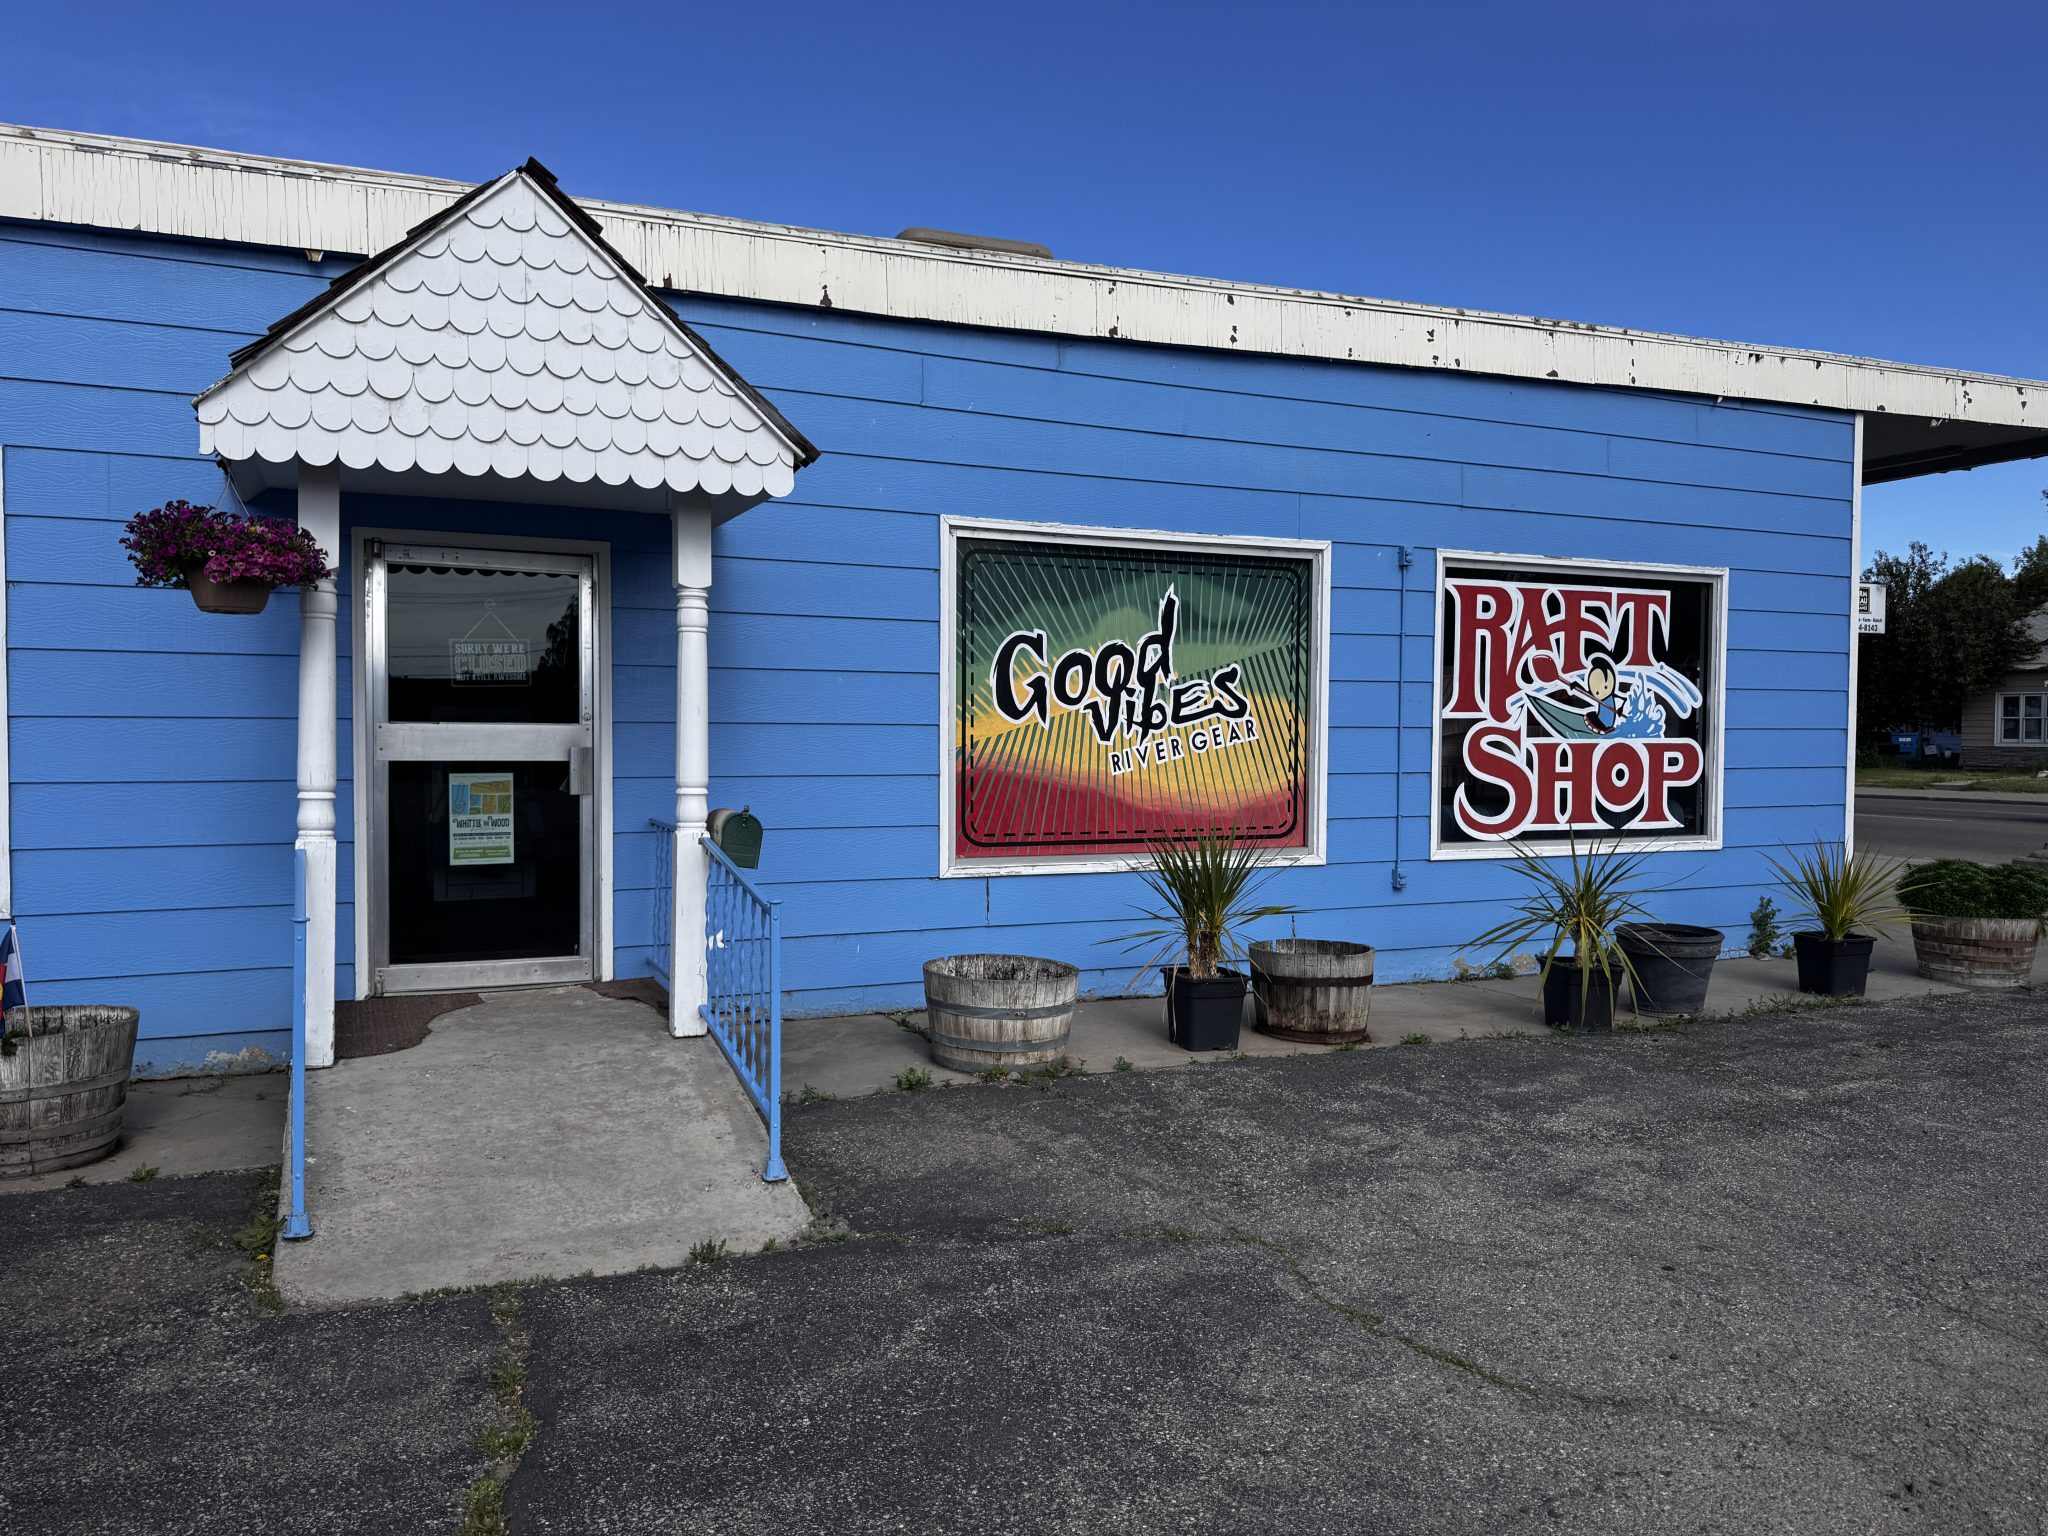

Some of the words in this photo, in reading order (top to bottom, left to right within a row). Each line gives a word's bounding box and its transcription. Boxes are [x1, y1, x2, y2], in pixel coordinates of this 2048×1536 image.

[455, 643, 489, 654] SORRY
[1444, 580, 1670, 724] RAFT
[454, 654, 527, 673] CLOSED
[493, 673, 527, 681] AWESOME
[1109, 738, 1185, 775] RIVER
[1190, 720, 1259, 755] GEAR
[1455, 723, 1703, 839] SHOP
[452, 818, 482, 828] WHITTLE
[488, 816, 510, 827] WOOD
